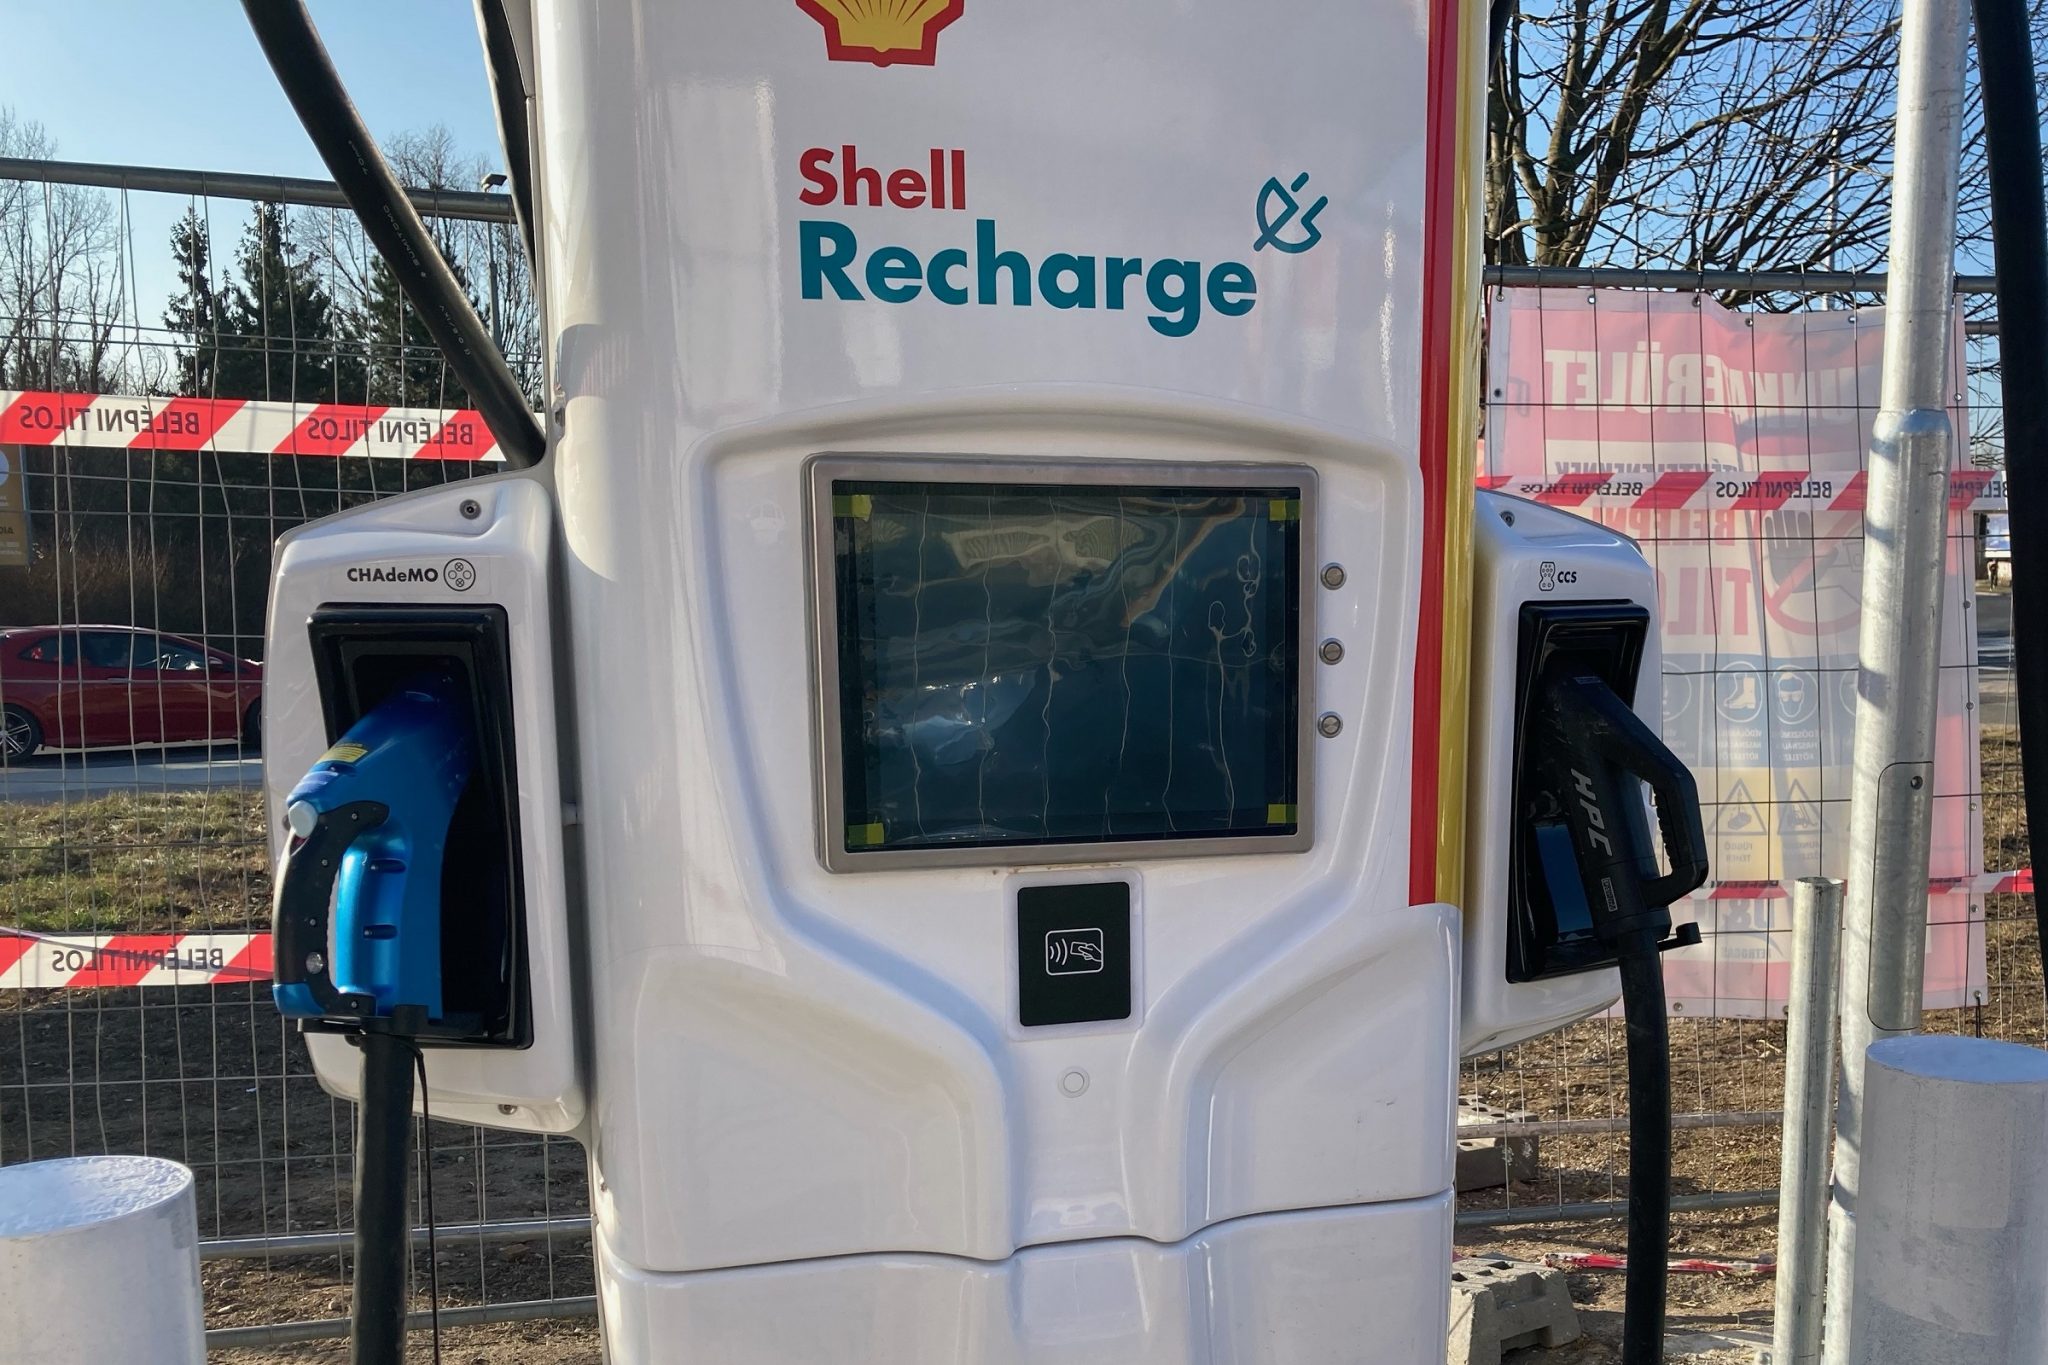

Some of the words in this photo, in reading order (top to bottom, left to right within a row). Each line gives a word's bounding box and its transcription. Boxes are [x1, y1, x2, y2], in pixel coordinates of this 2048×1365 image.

[799, 144, 966, 210] Shell
[383, 203, 421, 267] SUMITOMO
[799, 218, 1257, 337] Recharge
[347, 567, 438, 582] CHAdeMO
[1557, 571, 1577, 583] CCS
[1570, 768, 1613, 857] HPC
